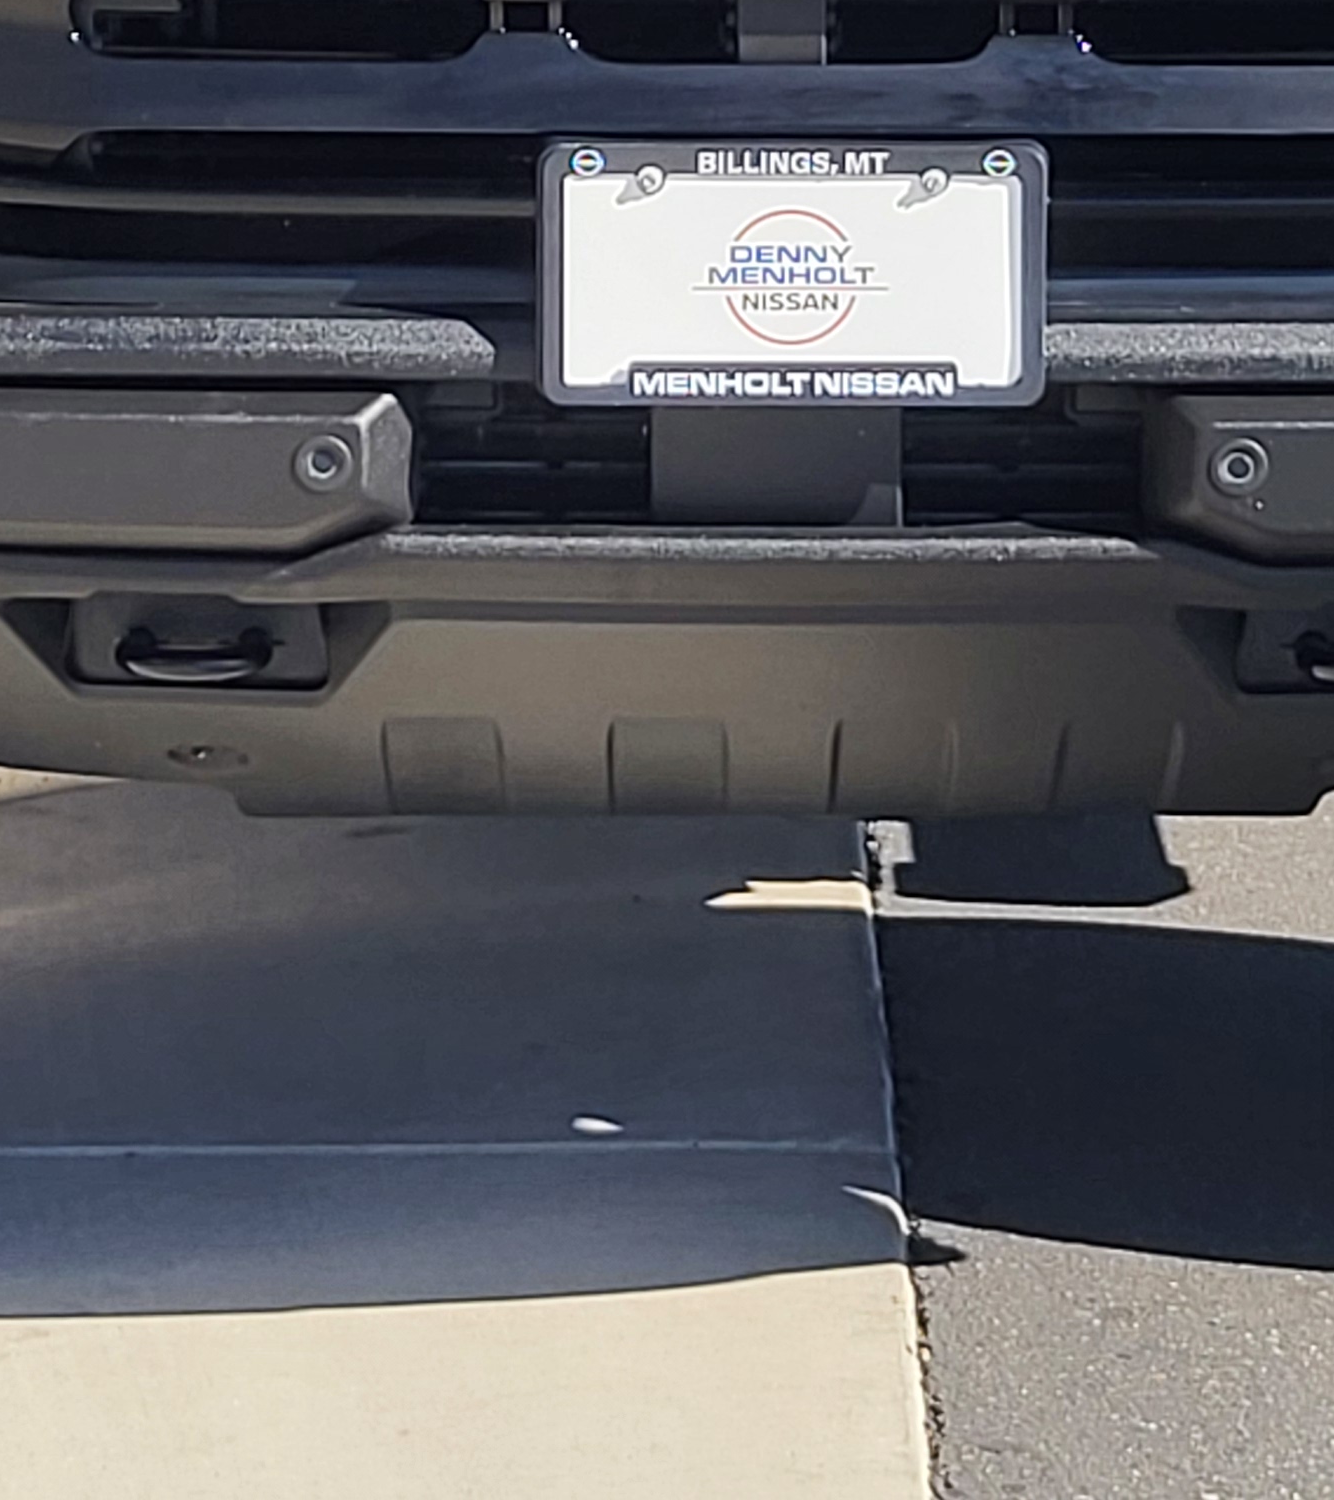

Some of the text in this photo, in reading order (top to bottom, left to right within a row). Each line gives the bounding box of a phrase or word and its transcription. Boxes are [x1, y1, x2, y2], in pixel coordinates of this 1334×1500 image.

[697, 150, 891, 177] BILLINGS, MT
[730, 245, 852, 263] DENNY
[708, 266, 875, 285] MENHOLT
[742, 292, 839, 311] NISSAN
[632, 370, 954, 397] MENHOLT NISSAN
